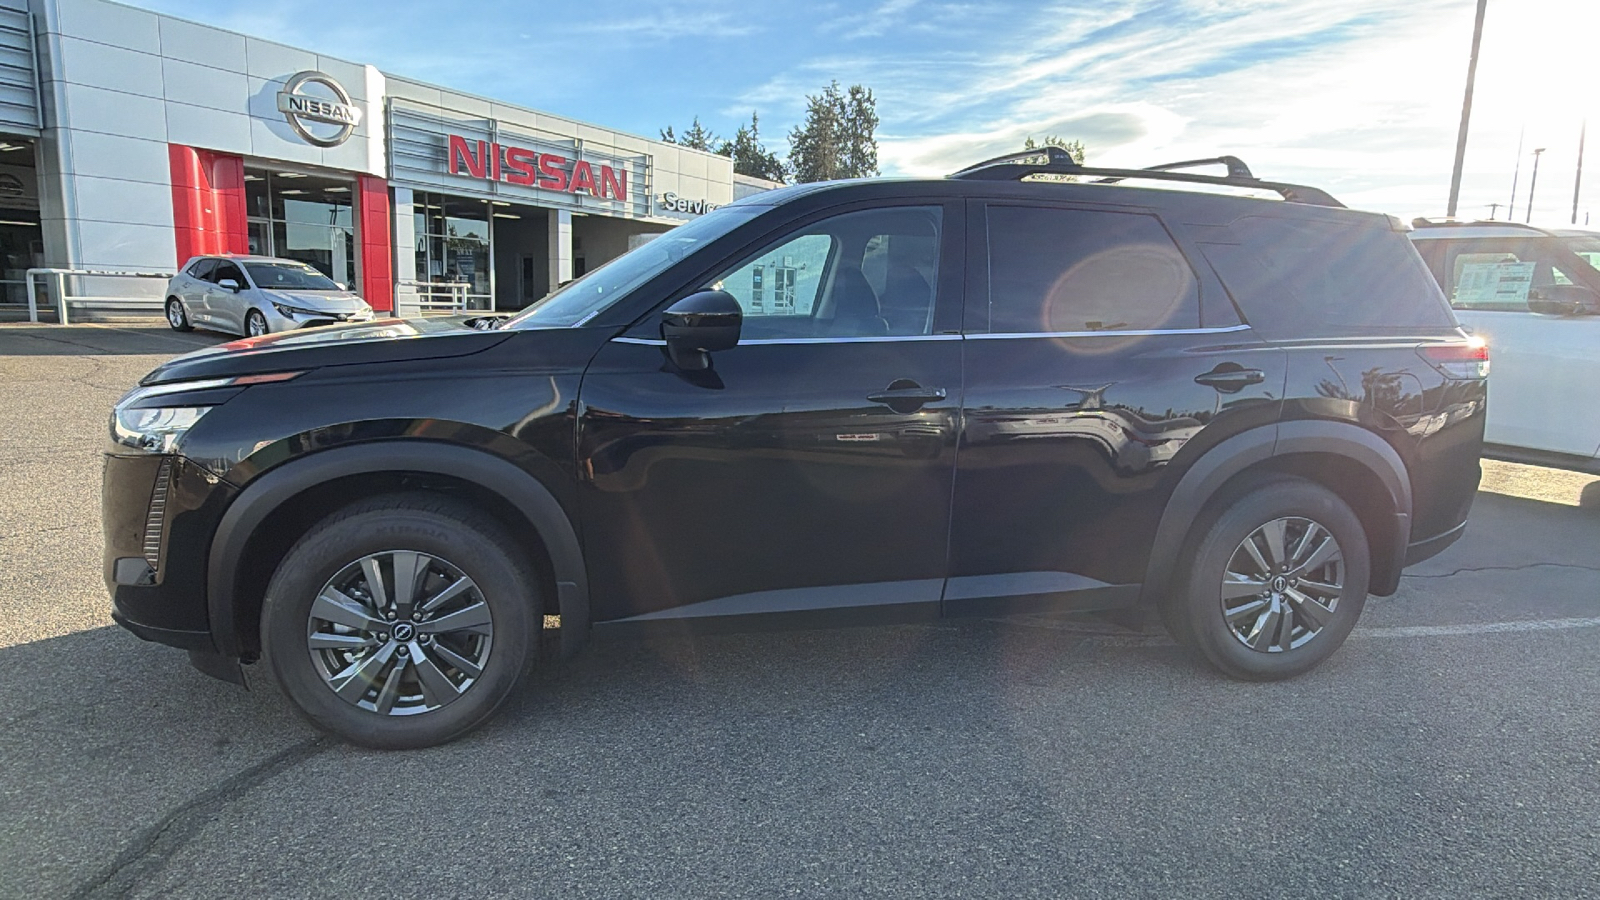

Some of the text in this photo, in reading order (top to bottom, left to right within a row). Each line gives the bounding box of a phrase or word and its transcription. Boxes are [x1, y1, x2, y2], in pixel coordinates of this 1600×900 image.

[288, 96, 354, 122] NISSAN
[448, 134, 627, 201] NISSAN
[664, 191, 722, 215] Servic
